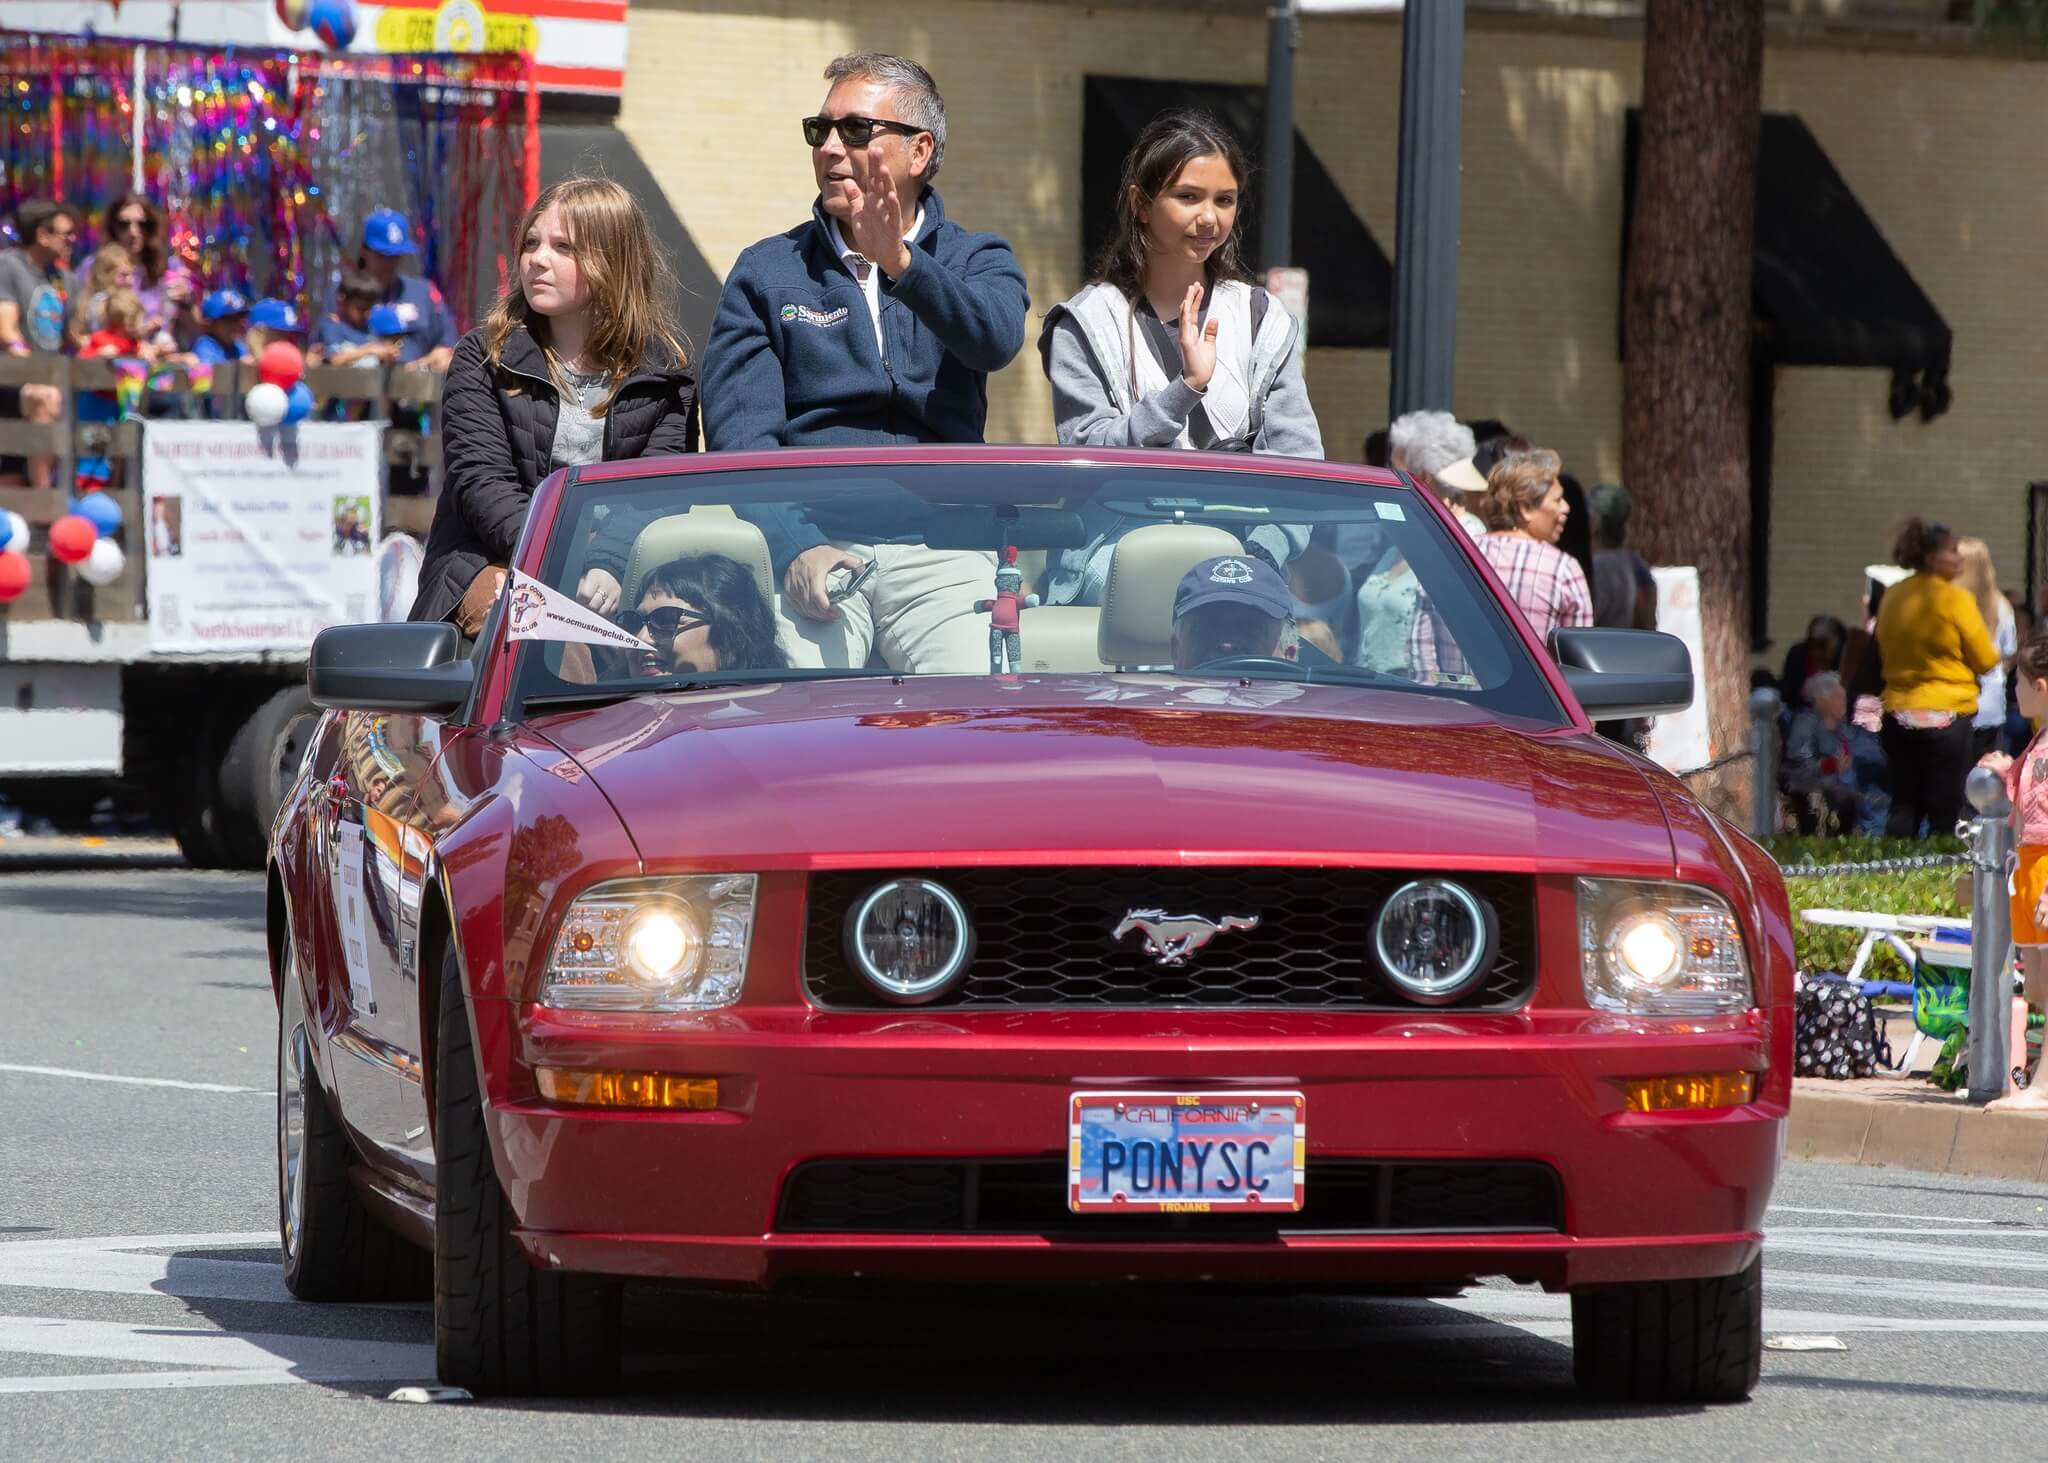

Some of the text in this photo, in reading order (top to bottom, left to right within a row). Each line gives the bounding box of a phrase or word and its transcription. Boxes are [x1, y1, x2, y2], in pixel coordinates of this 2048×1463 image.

[521, 621, 539, 633] CLUB
[546, 611, 640, 648] www.ocmustangclub.org
[1176, 1096, 1201, 1106] USC
[1124, 1106, 1250, 1123] CALIFORNIA
[1102, 1140, 1270, 1193] PONYSC
[1159, 1202, 1211, 1213] TROJANS
